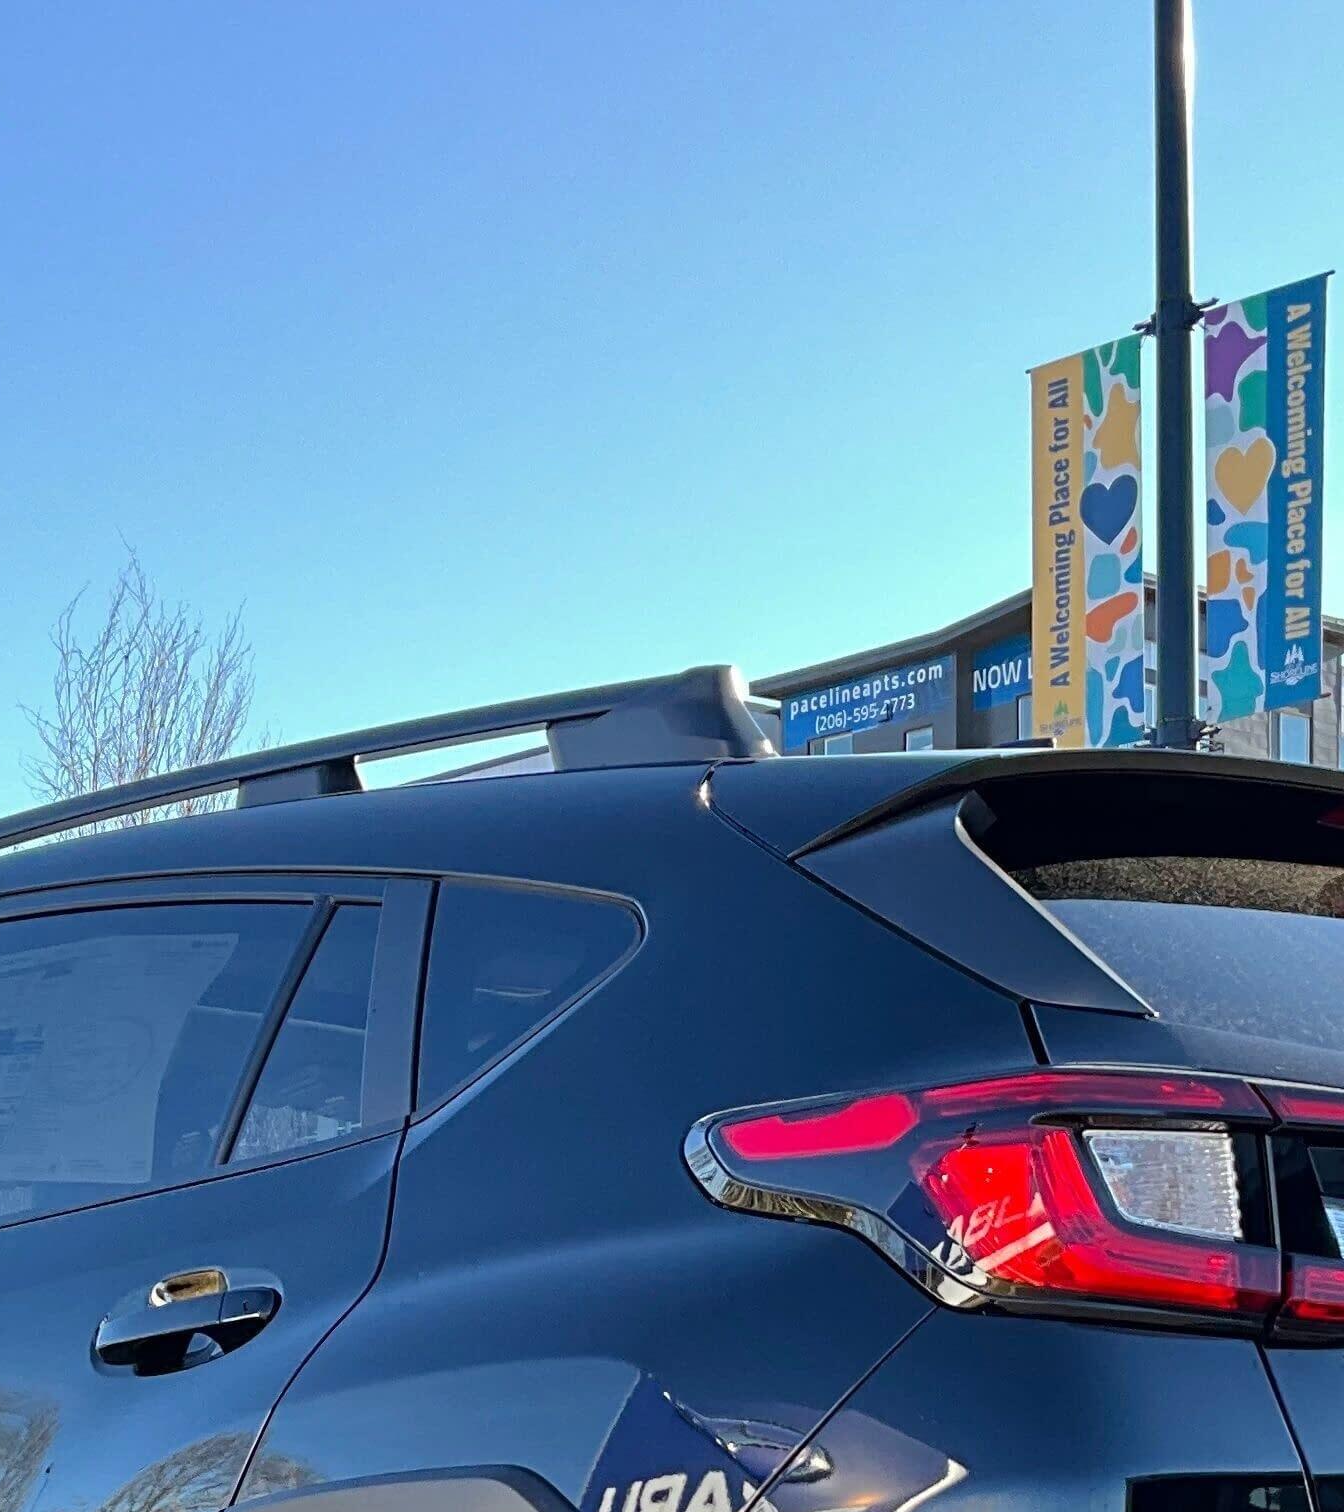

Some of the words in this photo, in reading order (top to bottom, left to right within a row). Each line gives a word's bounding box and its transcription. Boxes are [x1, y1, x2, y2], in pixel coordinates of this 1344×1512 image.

[1287, 303, 1311, 323] A
[1048, 378, 1069, 409] All
[1282, 322, 1312, 478] Welcoming
[1048, 417, 1070, 453] for
[1049, 458, 1070, 526] Place
[1286, 479, 1312, 554] Place
[1285, 558, 1311, 598] for
[1049, 529, 1075, 669] Welcoming
[1285, 607, 1311, 640] All
[790, 664, 943, 721] pacelineapts.com
[972, 660, 1022, 693] NOW
[1050, 671, 1070, 688] A
